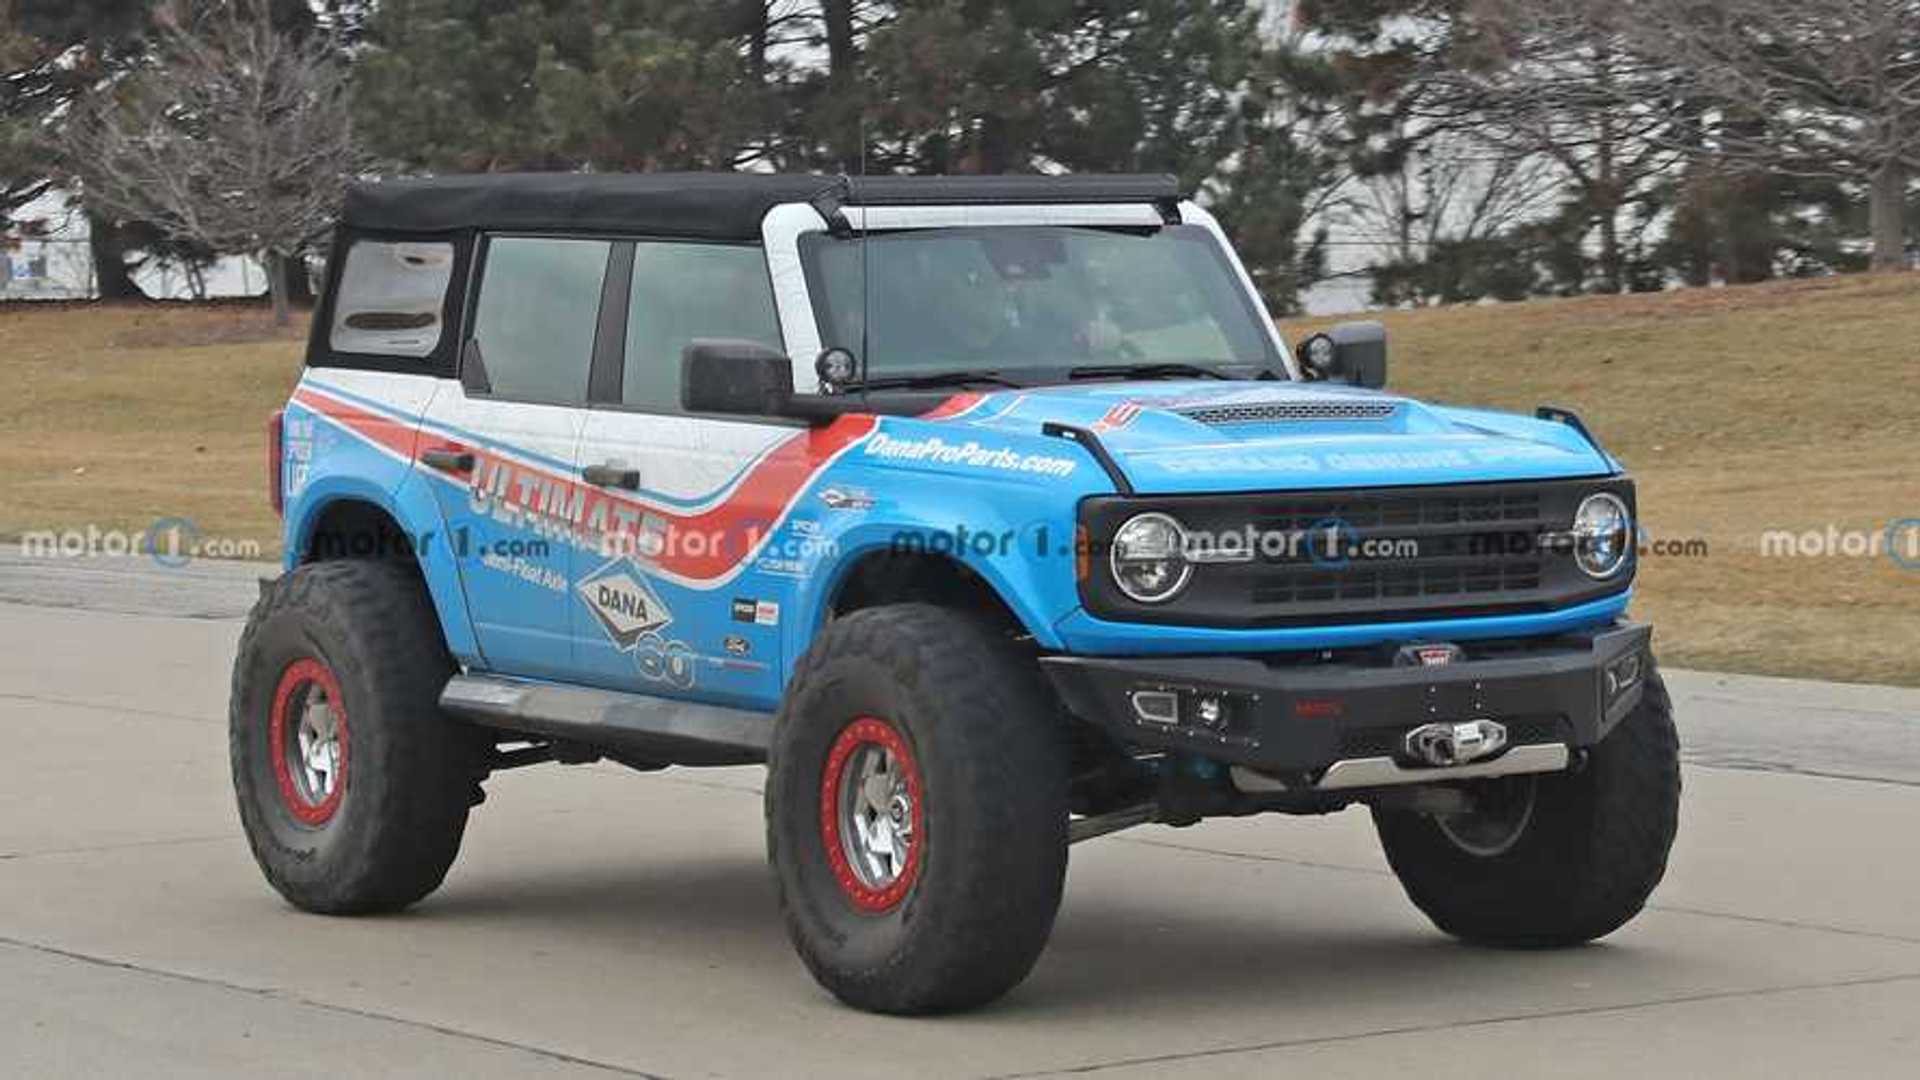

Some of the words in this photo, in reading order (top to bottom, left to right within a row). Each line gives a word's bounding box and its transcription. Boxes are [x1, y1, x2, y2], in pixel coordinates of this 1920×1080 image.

[863, 432, 1076, 477] DanaProParts.com
[468, 457, 668, 558] ULTIMATE
[597, 584, 649, 623] DANA
[632, 631, 695, 690] 60
